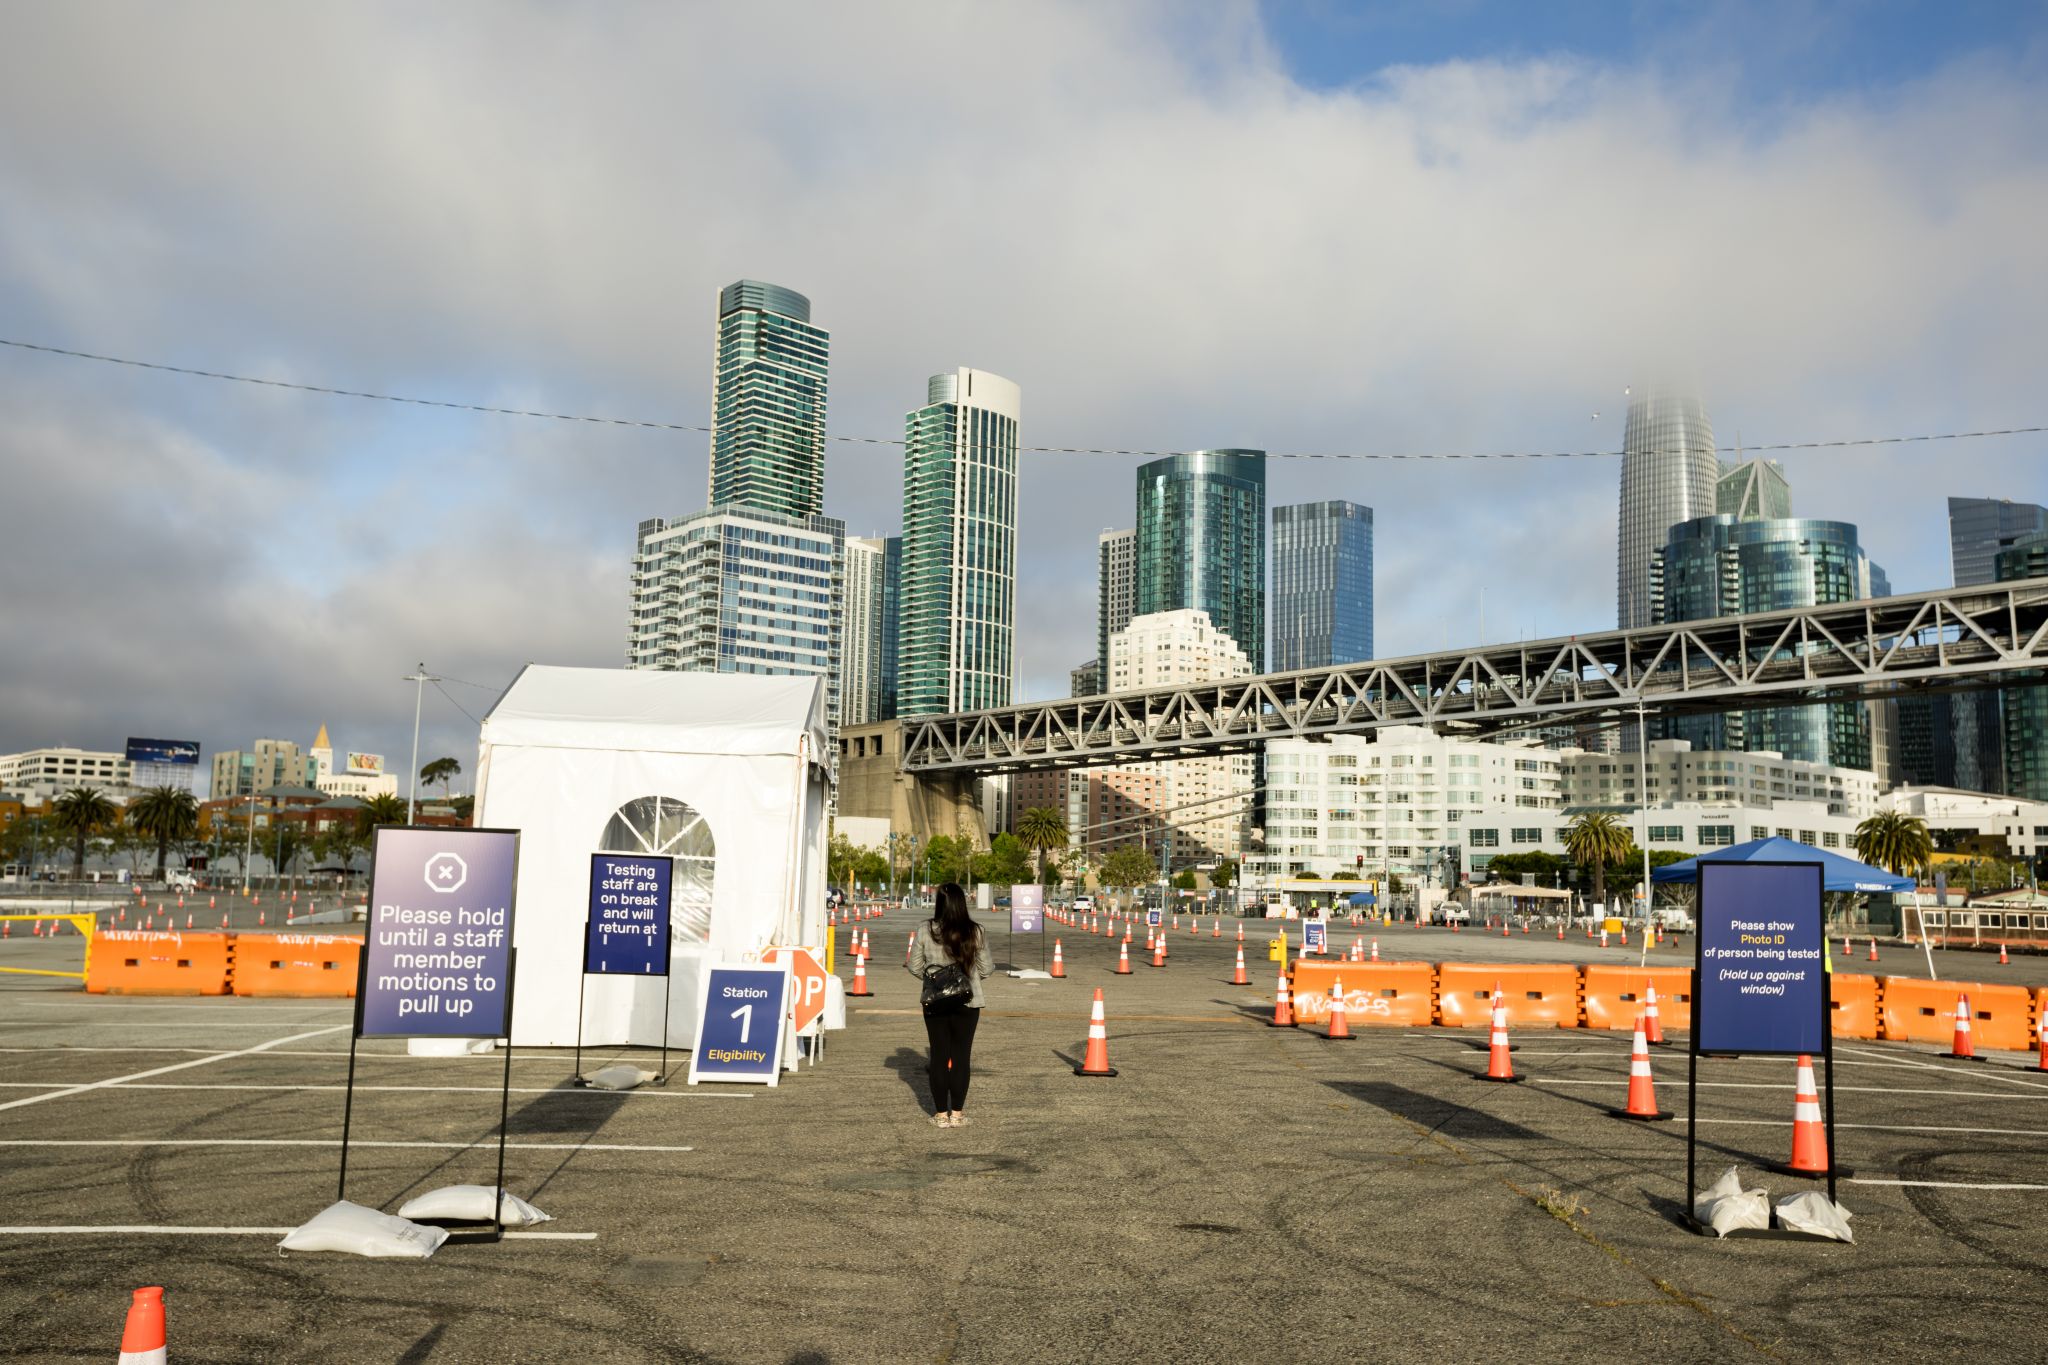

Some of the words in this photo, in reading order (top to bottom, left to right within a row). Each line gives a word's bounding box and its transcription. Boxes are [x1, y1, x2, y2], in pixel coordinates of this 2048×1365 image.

[606, 863, 656, 880] Testing
[602, 877, 635, 891] staff
[637, 881, 658, 892] are
[600, 895, 618, 905] on
[621, 893, 658, 906] break
[379, 905, 451, 925] Please
[458, 906, 505, 926] hold
[603, 907, 628, 919] and
[631, 908, 654, 920] will
[598, 923, 640, 935] return
[643, 923, 657, 935] at
[1731, 920, 1765, 931] Please
[1767, 920, 1795, 931] show
[379, 928, 428, 947] until
[434, 934, 447, 947] a
[453, 928, 504, 948] staff
[1741, 934, 1772, 945] Photo
[1774, 934, 1785, 945] ID
[393, 950, 487, 970] member
[1704, 947, 1717, 957] of
[1717, 949, 1754, 960] person
[1756, 948, 1785, 961] being
[1787, 948, 1820, 959] tested
[378, 972, 469, 991] motions
[474, 973, 496, 992] to
[1719, 969, 1748, 981] (Hold
[1750, 971, 1764, 982] up
[1766, 970, 1805, 982] against
[722, 986, 768, 999] Station
[1741, 984, 1785, 996] window)
[399, 995, 439, 1017] pull
[445, 998, 473, 1018] up
[730, 1004, 753, 1044] 1
[708, 1049, 767, 1063] Eligibility
